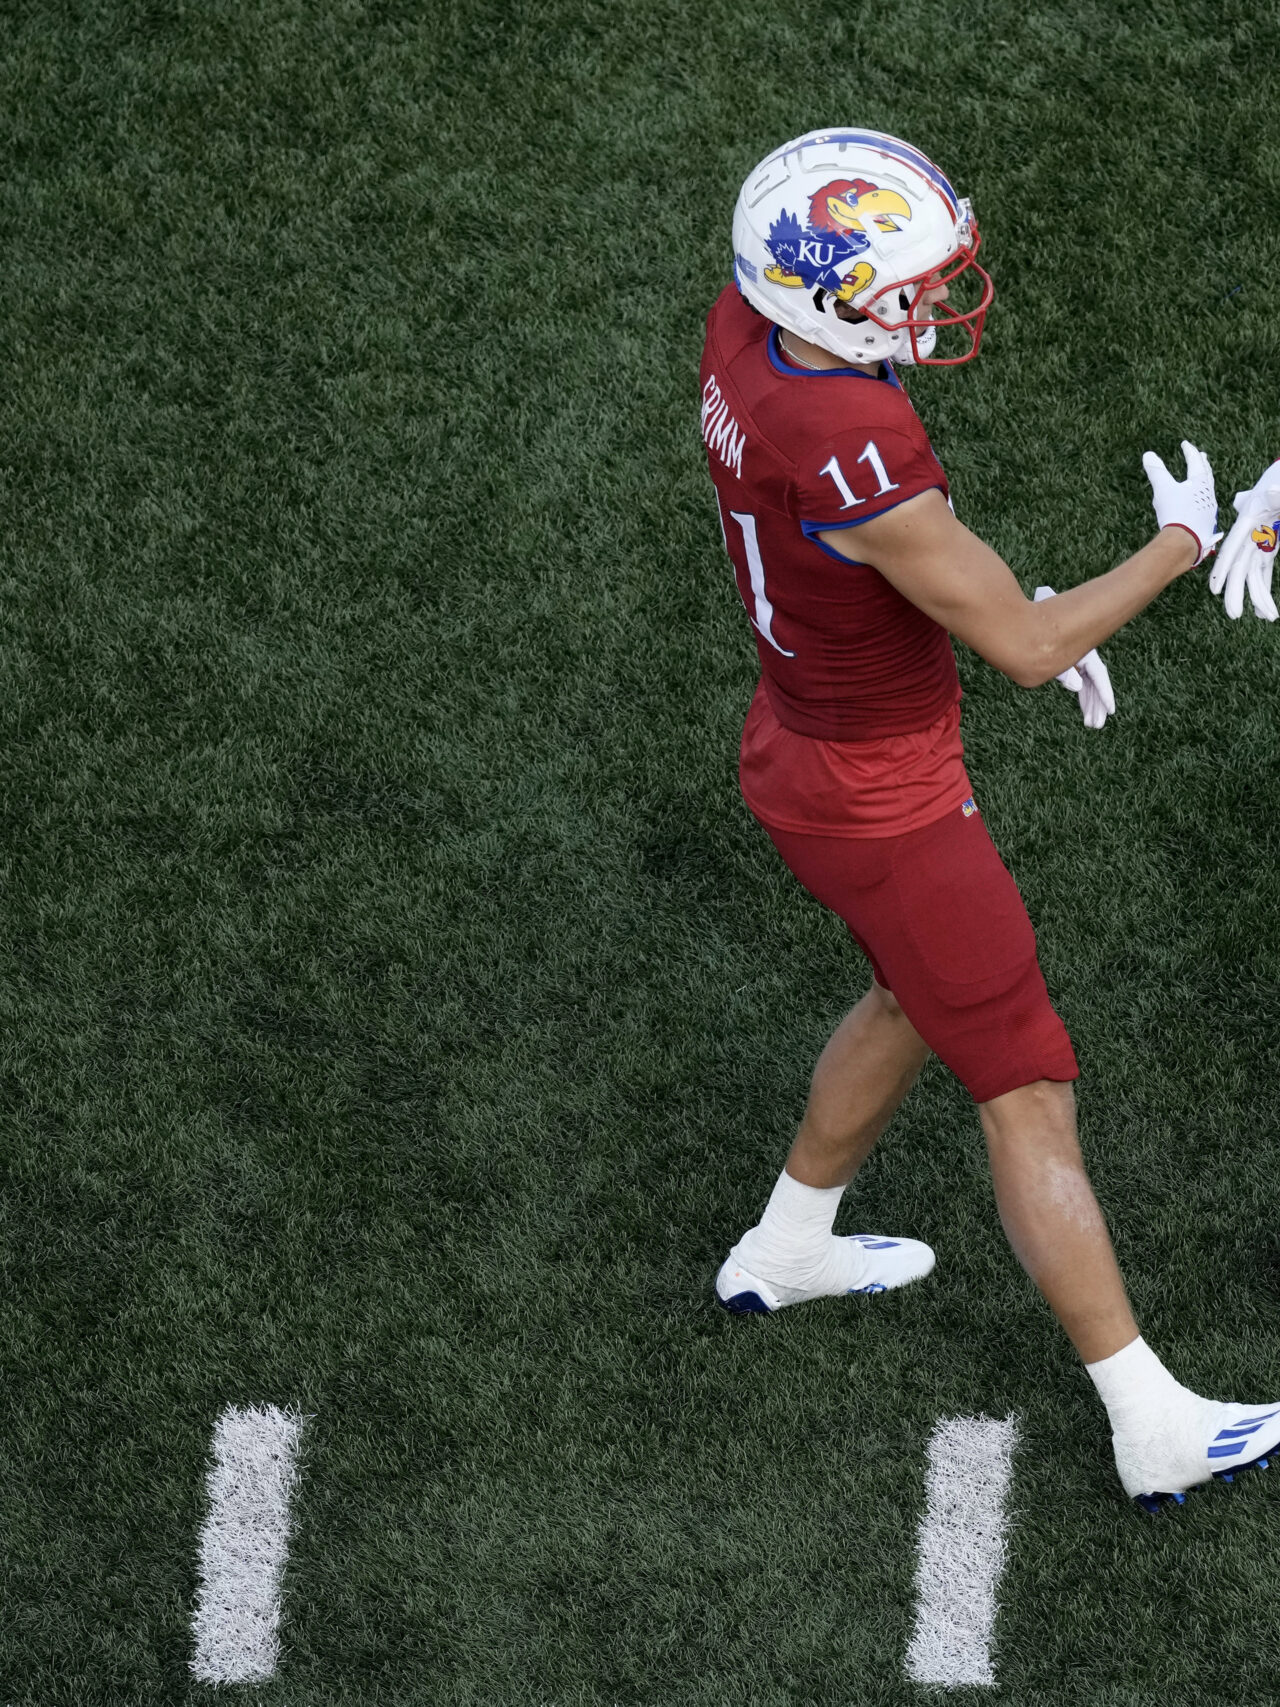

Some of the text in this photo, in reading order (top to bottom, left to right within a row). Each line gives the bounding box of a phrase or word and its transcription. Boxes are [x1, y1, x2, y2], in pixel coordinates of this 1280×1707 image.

[799, 239, 836, 267] KU
[818, 439, 900, 511] 11
[728, 510, 797, 659] 1
